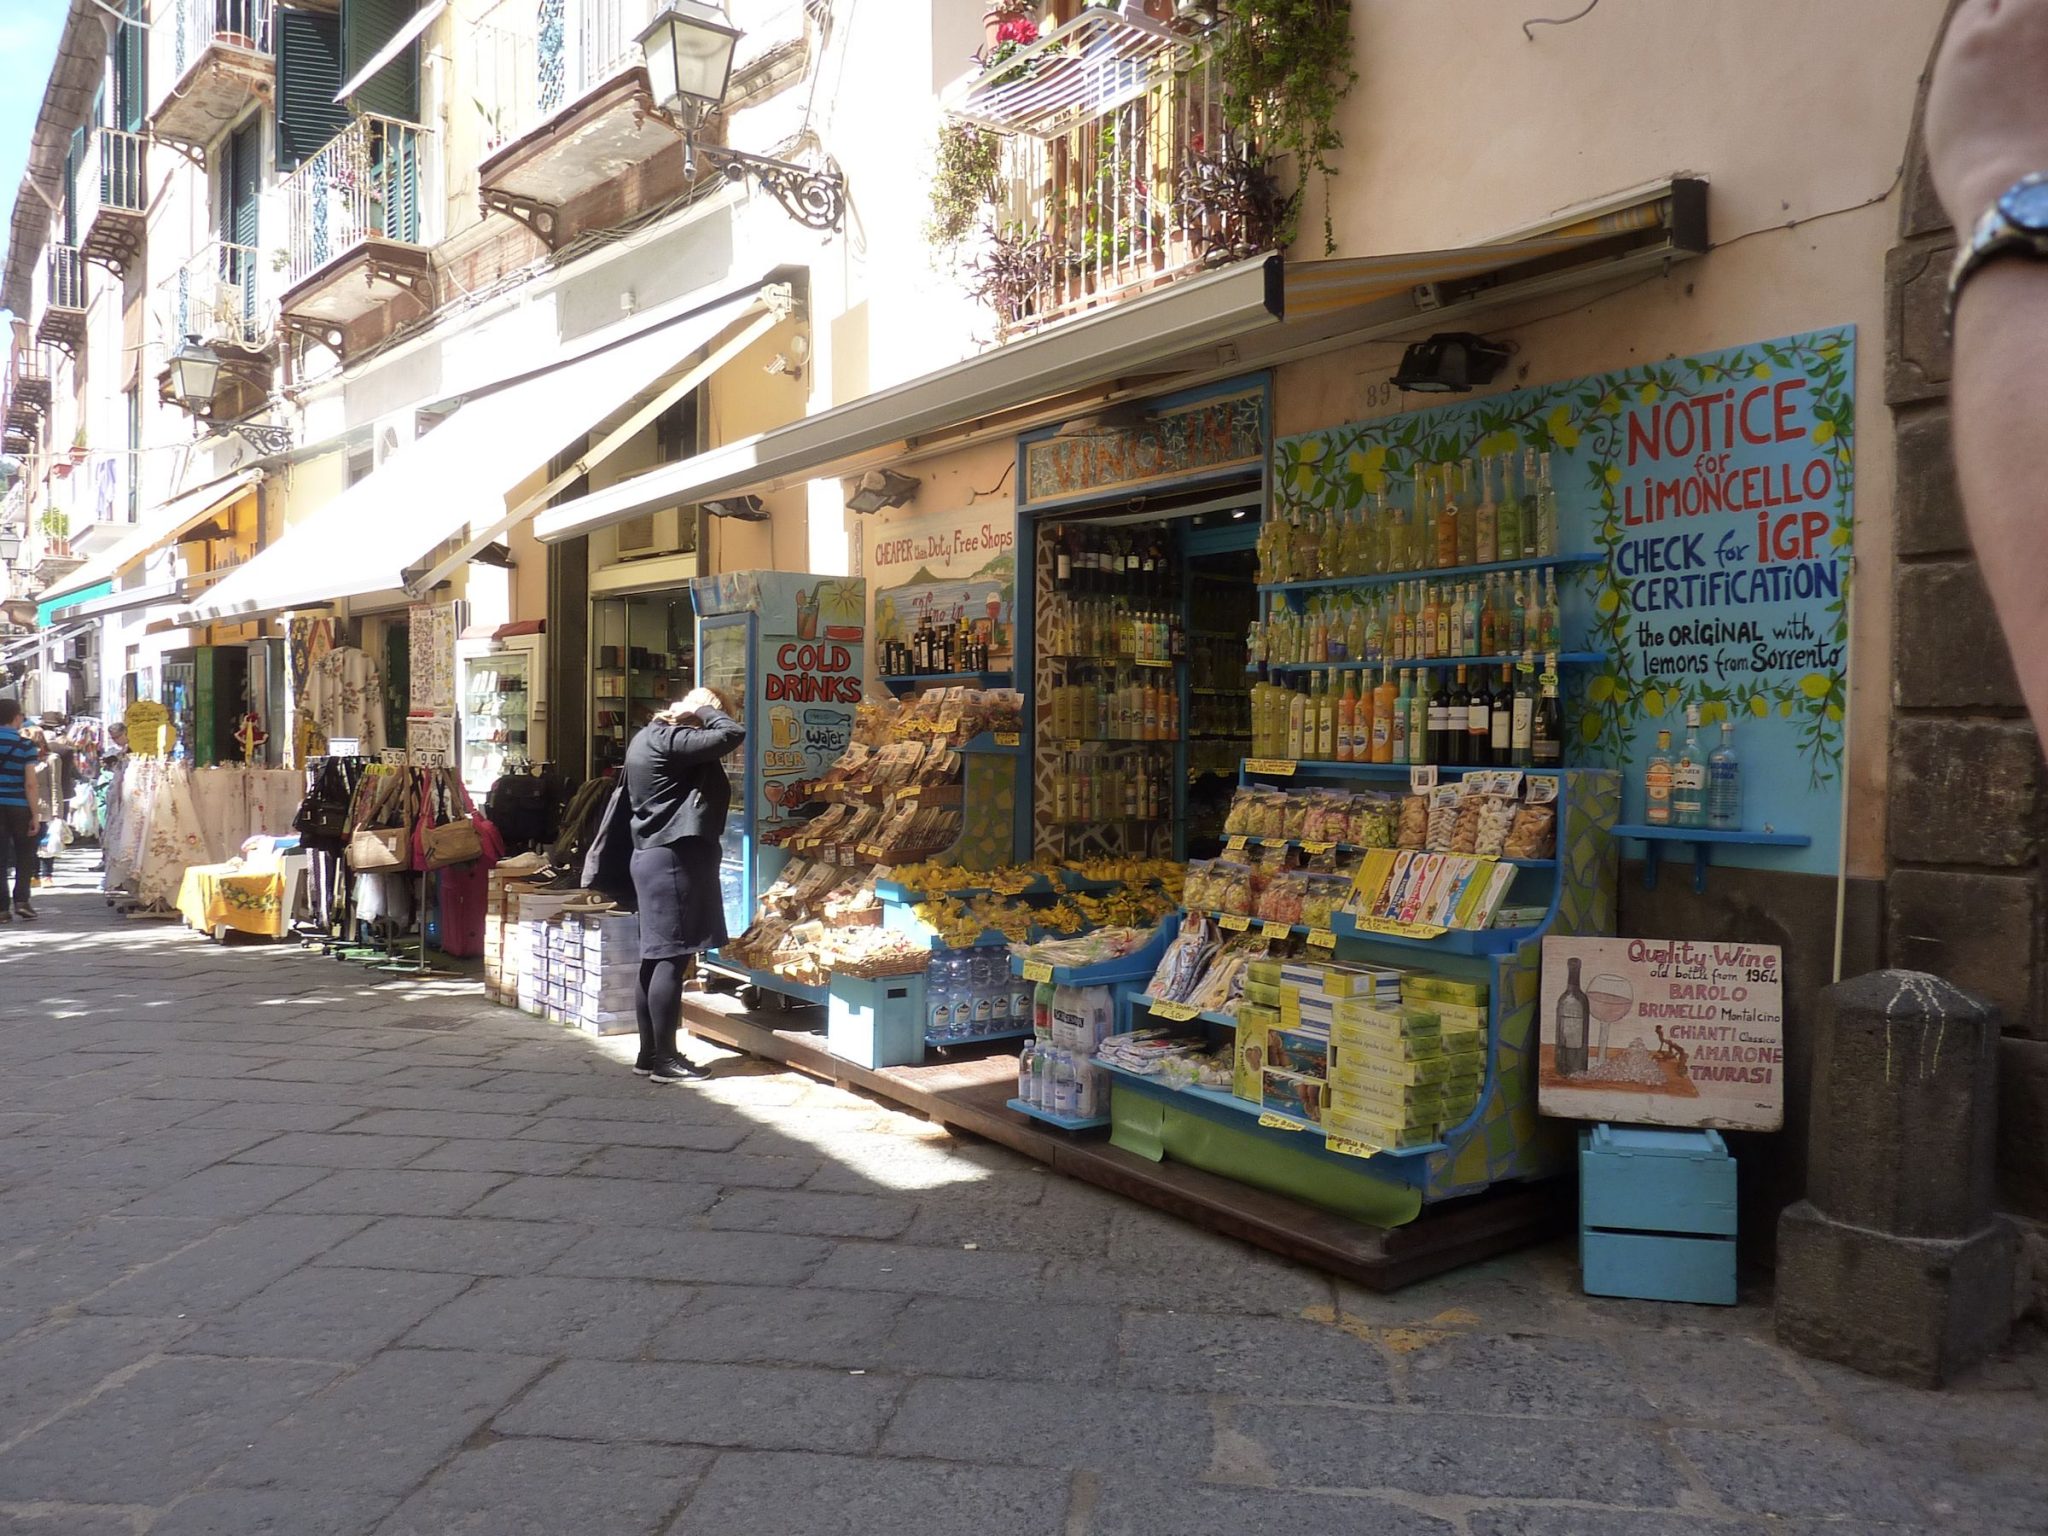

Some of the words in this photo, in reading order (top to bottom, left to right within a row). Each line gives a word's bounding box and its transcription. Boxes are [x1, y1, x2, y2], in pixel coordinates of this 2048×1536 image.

[1366, 382, 1390, 407] 89
[1694, 452, 1730, 477] for
[876, 538, 913, 566] CHEAPER
[953, 529, 978, 554] Free
[981, 524, 1013, 553] Shops
[1617, 532, 1706, 575] CHECK
[1714, 529, 1749, 571] for
[1636, 621, 1664, 647] the
[1772, 613, 1815, 640] with
[777, 643, 851, 672] COLD
[1643, 651, 1708, 676] lemons
[1714, 649, 1748, 680] from
[1751, 642, 1846, 672] Sorrento
[806, 728, 845, 746] Water
[764, 751, 805, 767] BEER
[1627, 939, 1707, 969] Quality
[1713, 944, 1777, 969] Wine
[1650, 963, 1669, 978] old
[1712, 969, 1738, 984] from
[1745, 969, 1778, 984] 1964
[1669, 984, 1748, 1002] BAROLO
[1638, 1002, 1717, 1020] BRUNELLO
[1721, 1007, 1781, 1023] Montalcino
[1693, 1045, 1783, 1064] AMARONE
[1690, 1066, 1772, 1084] TAURASI
